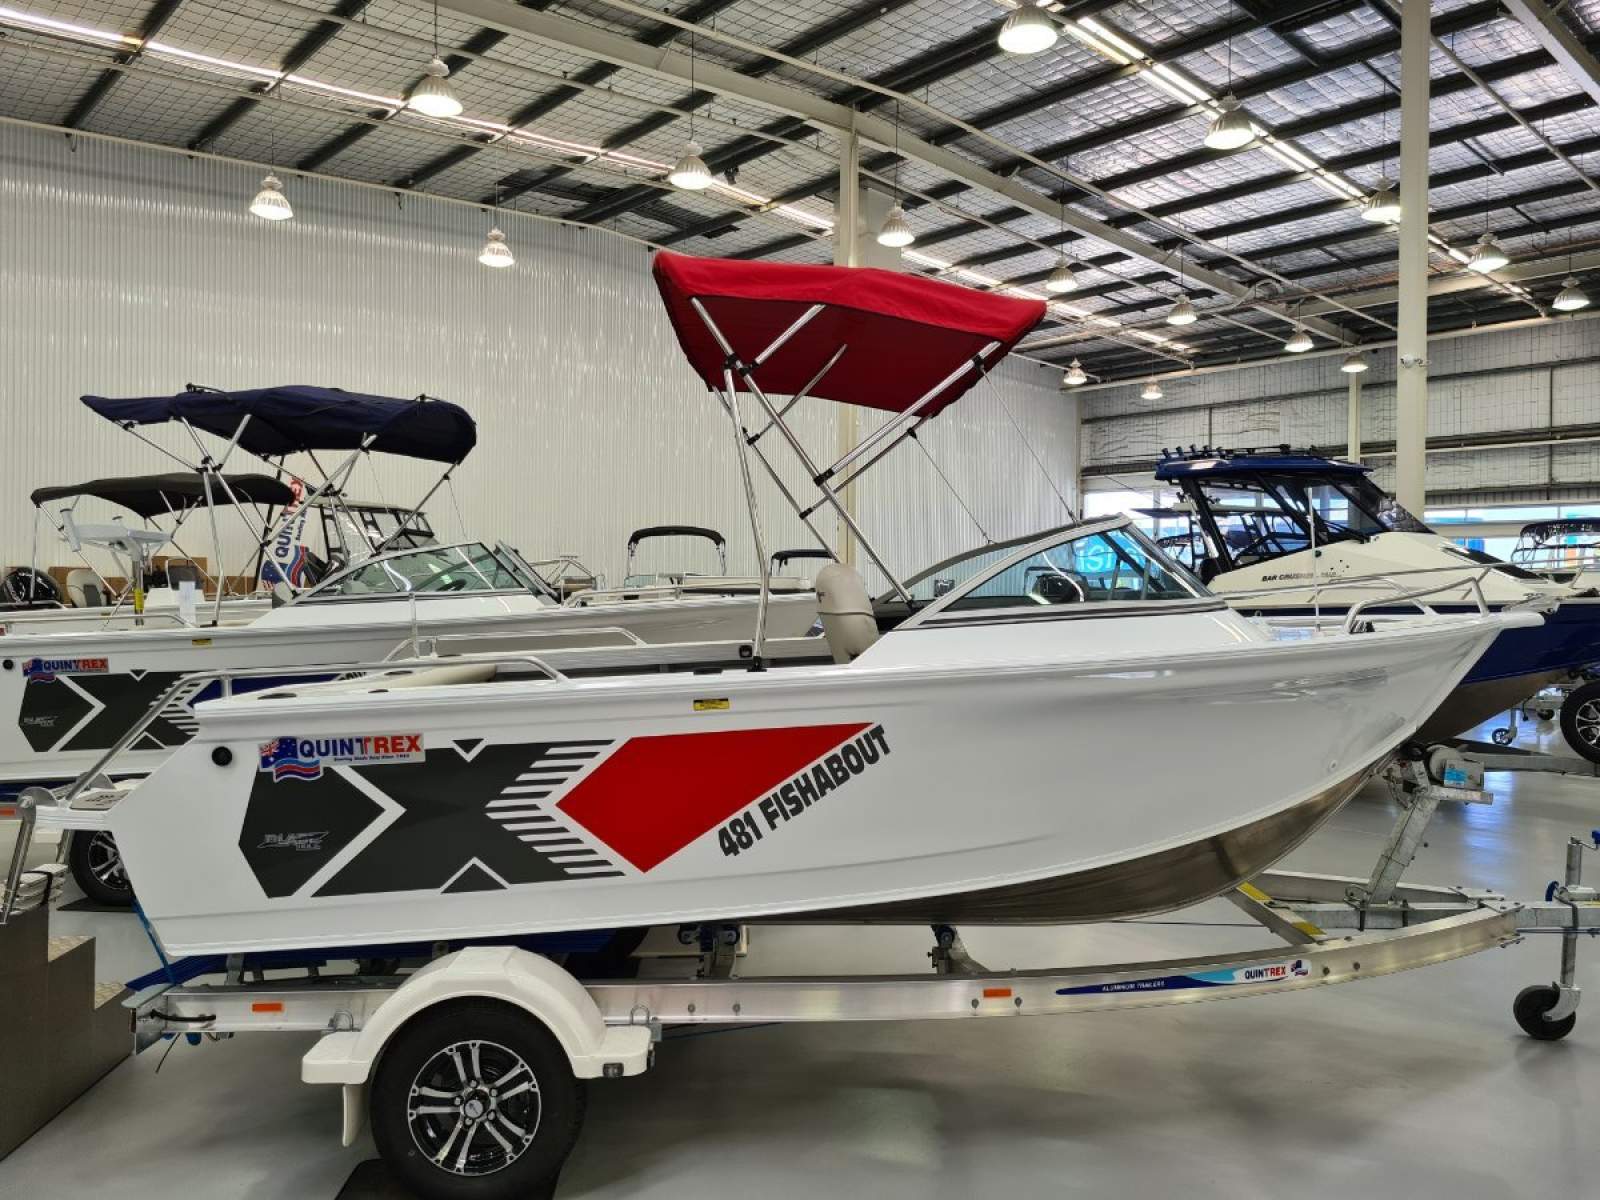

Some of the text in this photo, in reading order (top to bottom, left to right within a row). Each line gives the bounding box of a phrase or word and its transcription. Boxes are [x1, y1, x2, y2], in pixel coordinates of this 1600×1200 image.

[300, 736, 421, 758] QUINTREX
[718, 724, 891, 856] 481 FISHABOUT
[1244, 965, 1287, 980] QUINTREX
